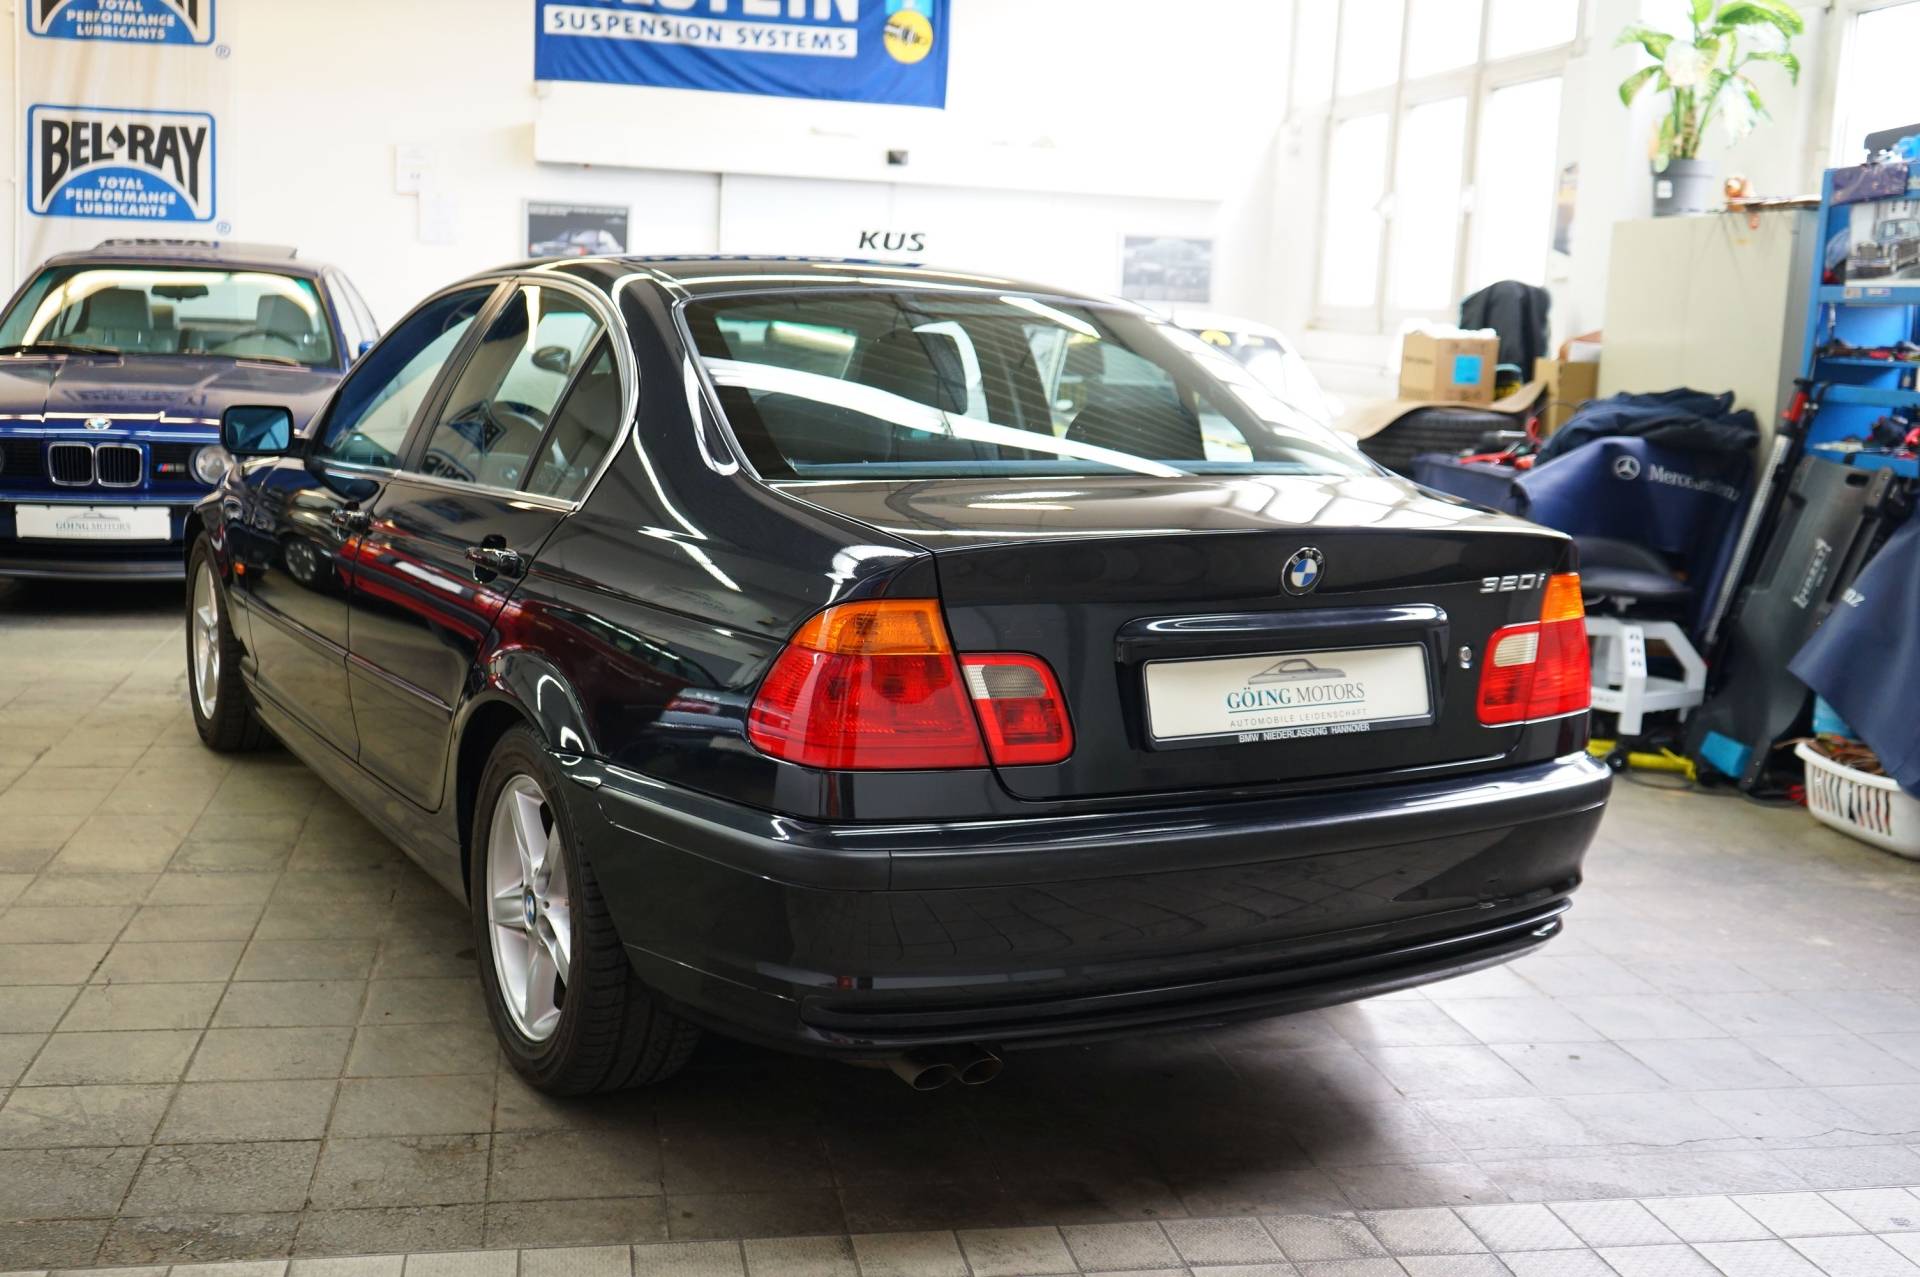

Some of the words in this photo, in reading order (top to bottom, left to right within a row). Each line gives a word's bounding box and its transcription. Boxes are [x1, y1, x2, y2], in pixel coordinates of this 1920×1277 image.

[98, 0, 143, 12] TOTAL
[66, 10, 176, 27] PERFORMANCE
[76, 24, 166, 40] LUBRICANTS
[554, 11, 723, 43] SUSPENSION
[737, 28, 847, 51] SYSTEMS
[98, 176, 144, 191] TOTAL
[65, 188, 176, 205] PERFORMANCE
[76, 202, 167, 217] LUBRICANTS
[1479, 573, 1546, 593] 320i
[1227, 686, 1291, 709] GÖING
[1297, 682, 1365, 704] MOTORS
[1230, 714, 1295, 728] AUTOMOBILE
[1299, 708, 1368, 722] LEIDENSCHAFT
[1238, 732, 1259, 743] BMW
[1263, 727, 1328, 741] NIEDERLASSUNG
[1331, 723, 1370, 735] HANNOVER
